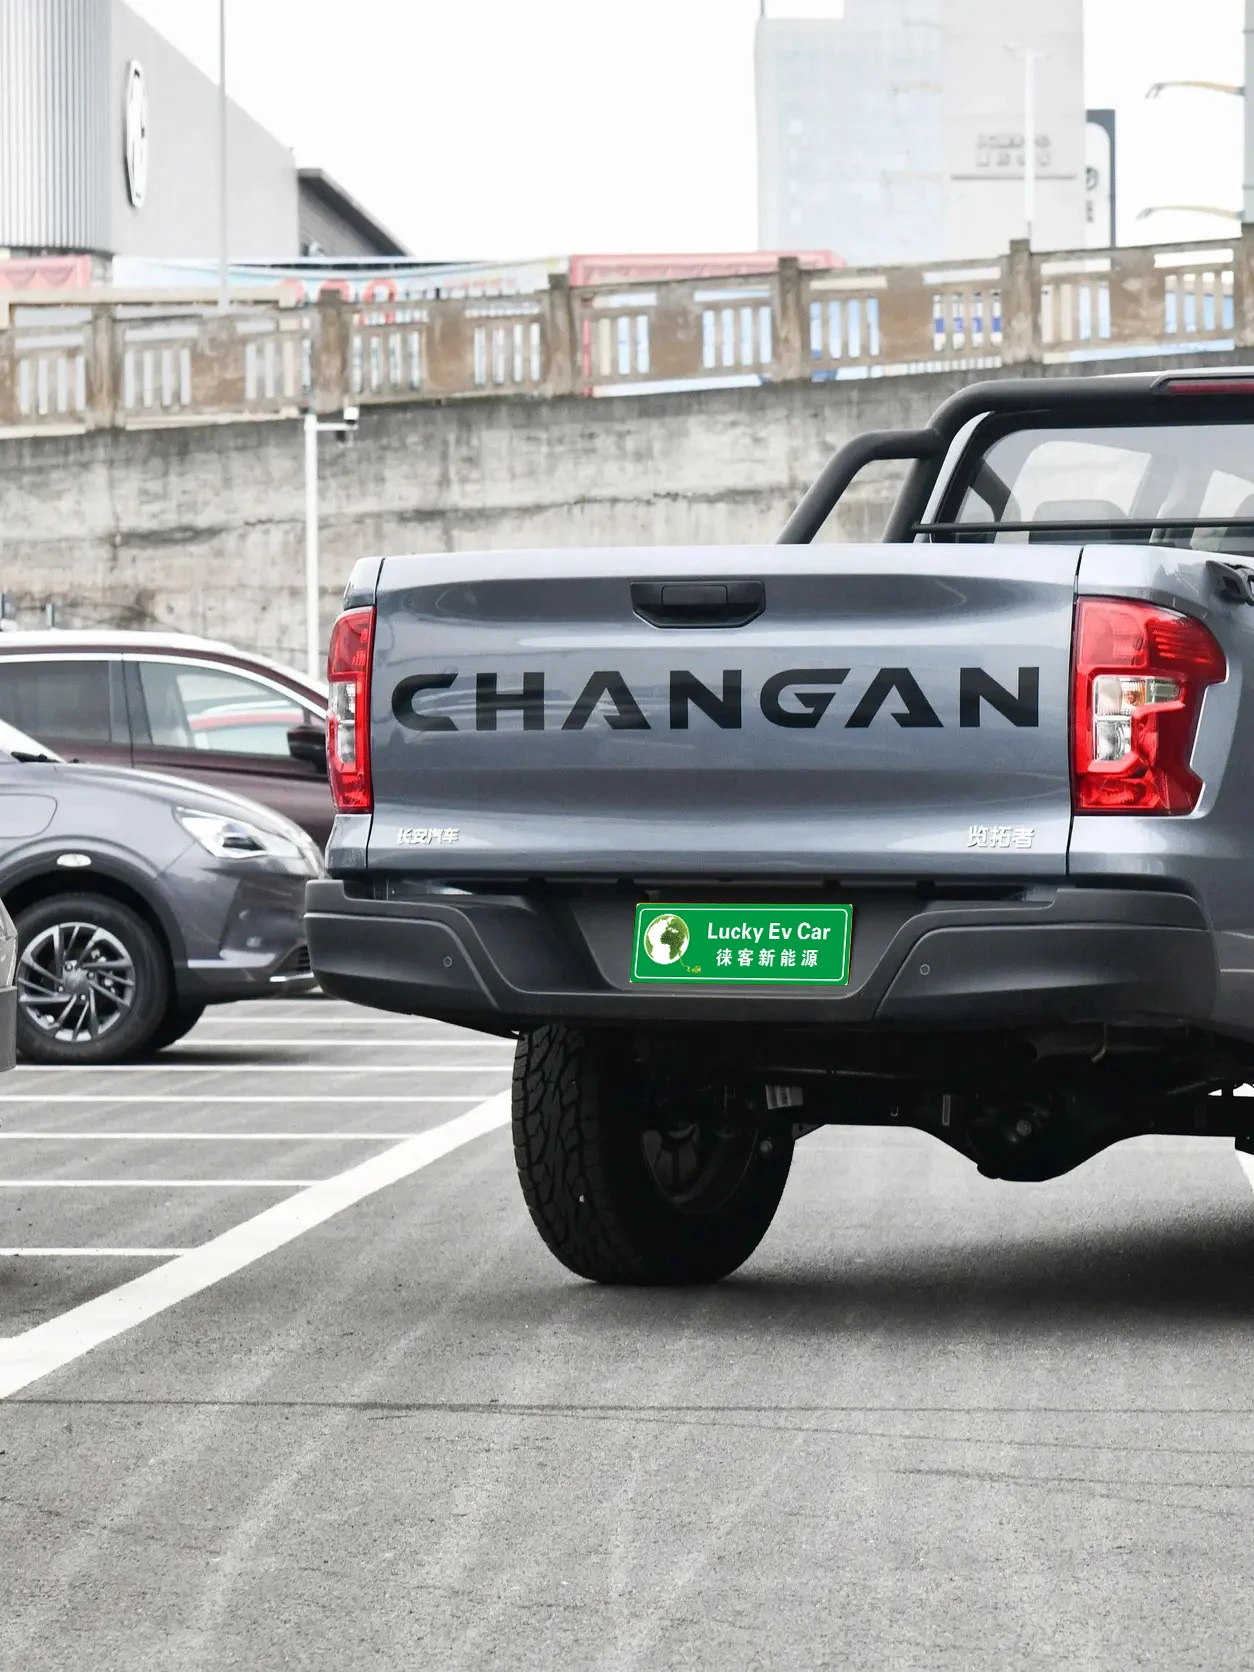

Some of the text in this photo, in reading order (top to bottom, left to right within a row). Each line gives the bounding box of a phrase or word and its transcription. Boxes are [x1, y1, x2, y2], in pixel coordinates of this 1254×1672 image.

[391, 666, 1040, 731] CHANGAN
[397, 828, 460, 845] 长安汽车
[967, 825, 1035, 849] 览拓者
[708, 921, 831, 943] Lucky Ev Car
[715, 947, 819, 967] 徕客新能源
